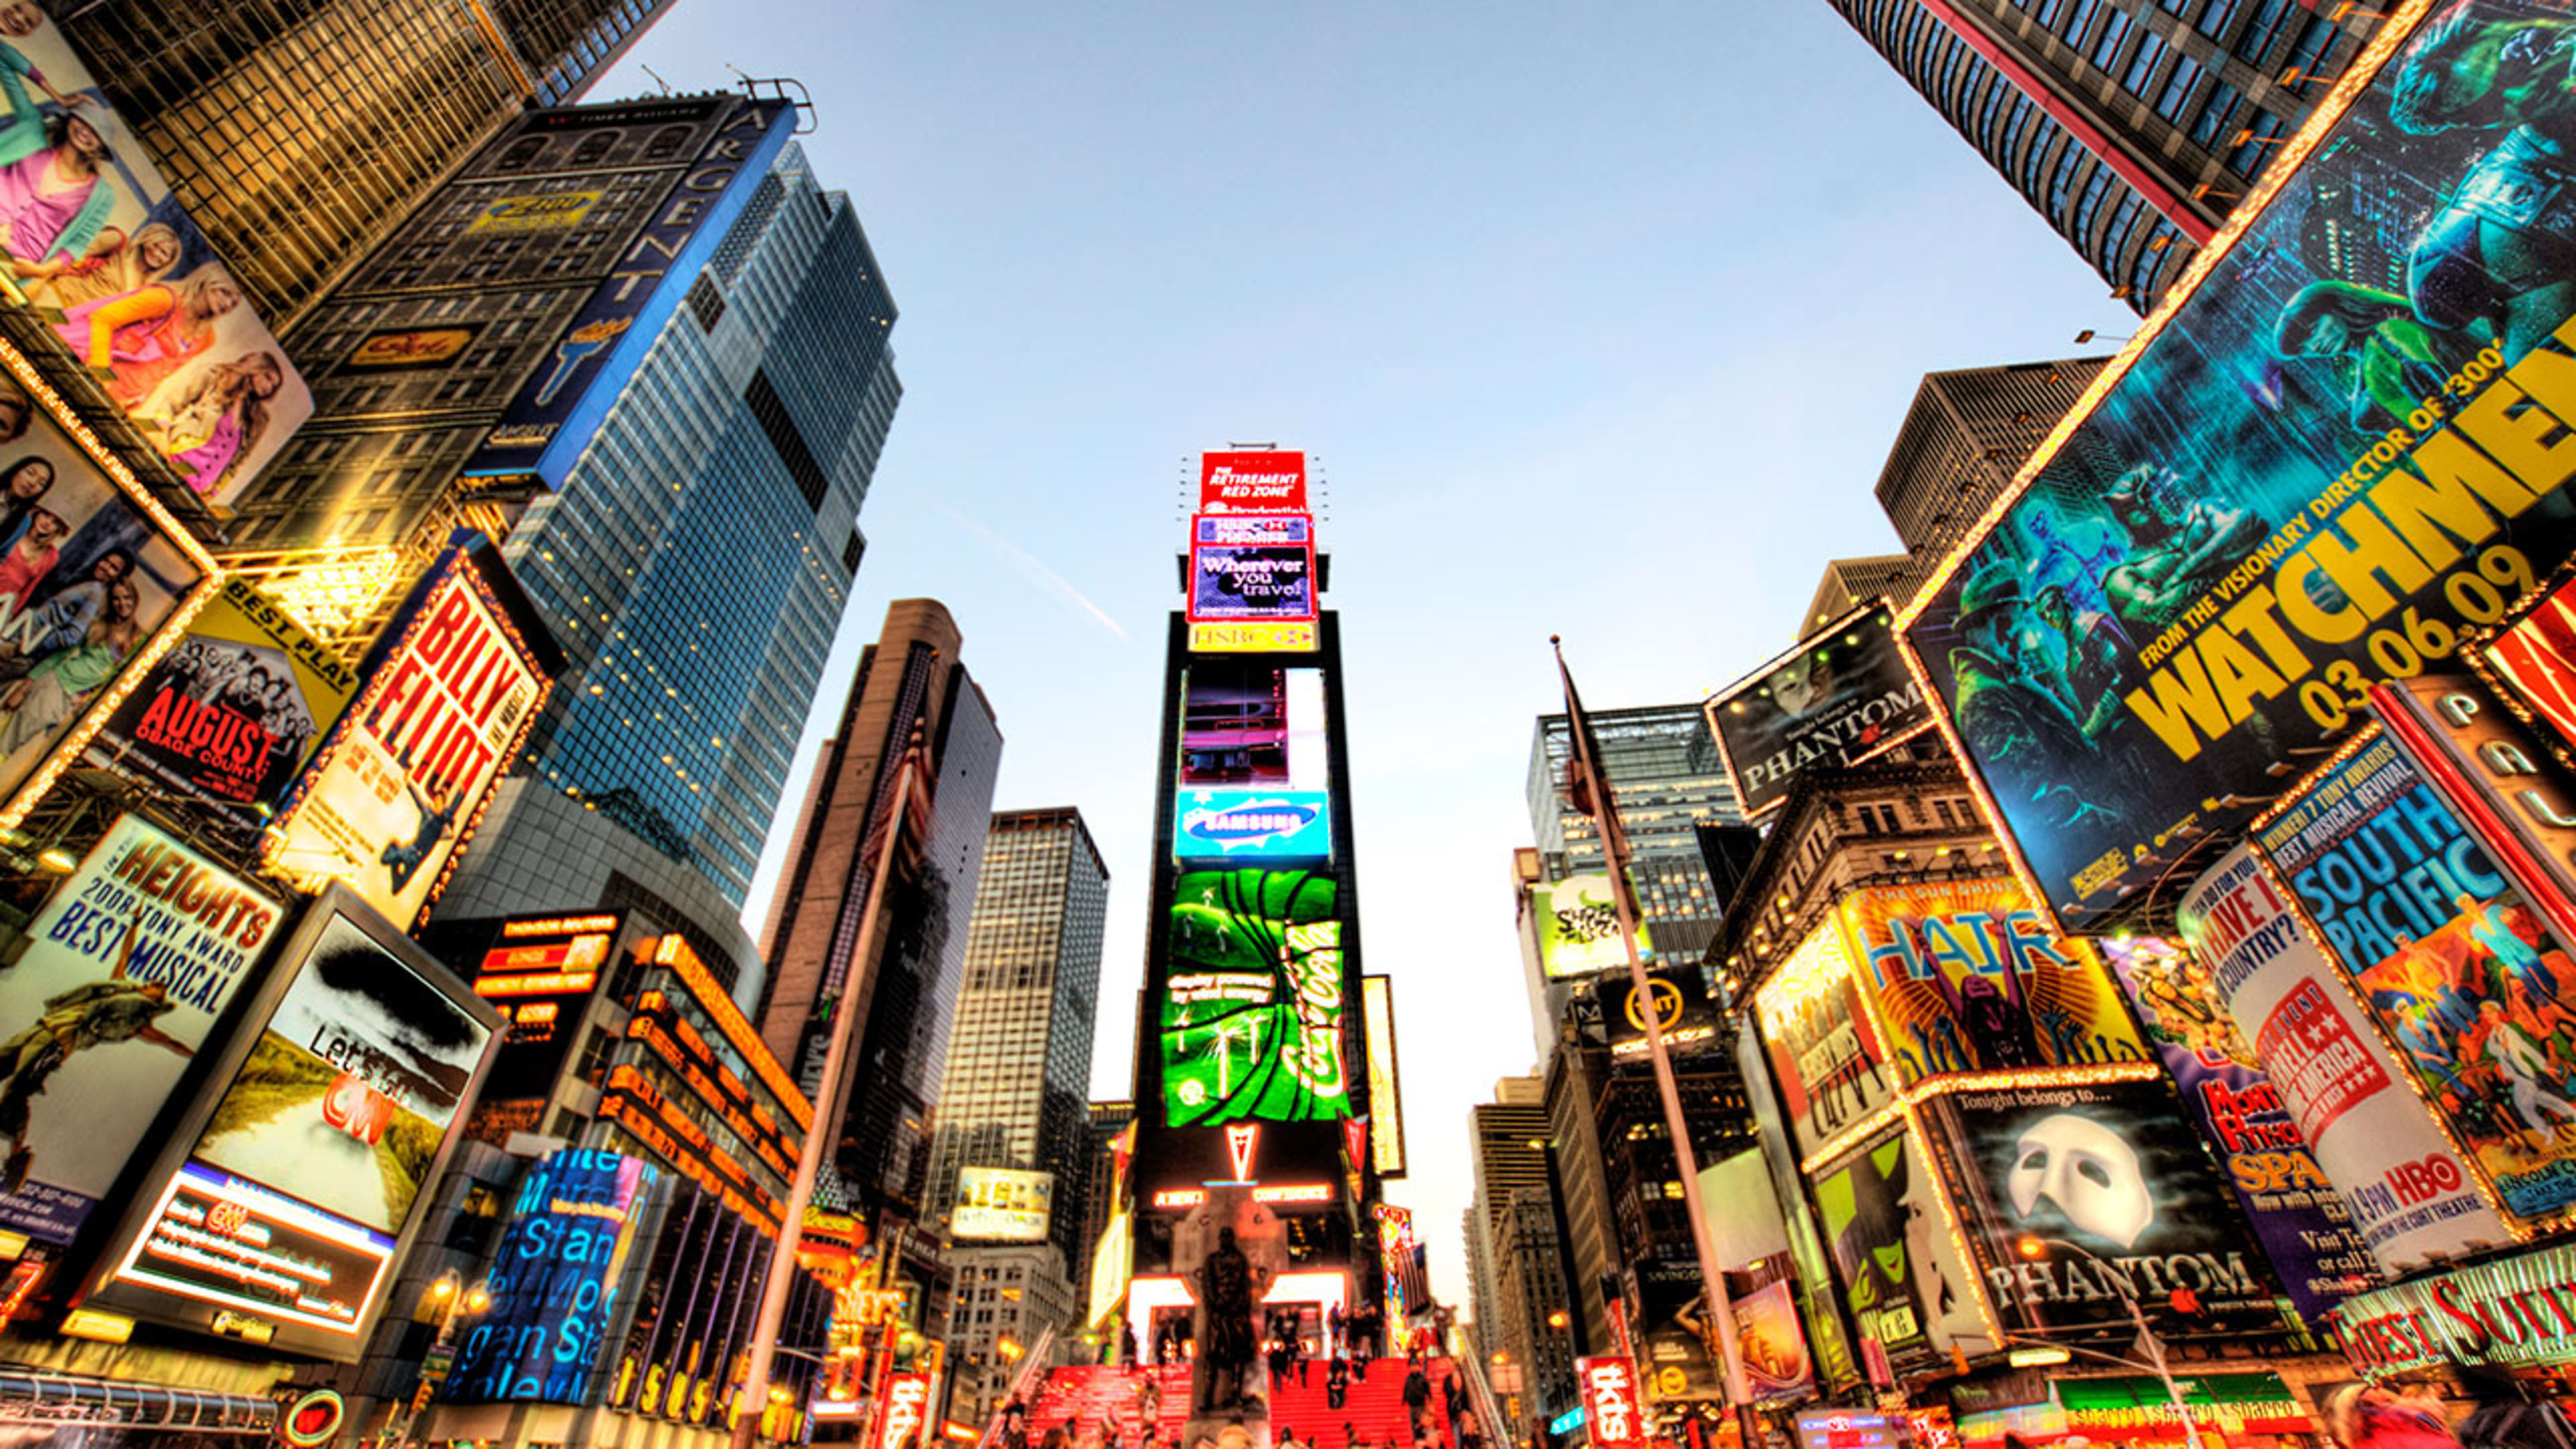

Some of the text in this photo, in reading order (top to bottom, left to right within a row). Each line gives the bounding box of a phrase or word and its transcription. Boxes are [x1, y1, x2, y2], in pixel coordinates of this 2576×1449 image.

[1209, 474, 1299, 485] RETIREMENT
[1221, 486, 1291, 498] RED ZONE
[1201, 556, 1303, 574] Wherever
[2139, 621, 2188, 670] FROM
[2183, 597, 2223, 640] THE
[2216, 514, 2314, 607] VISIONARY
[2309, 425, 2416, 521] DIRECTOR
[2407, 394, 2446, 433] OF
[1232, 572, 1273, 588] you
[1243, 582, 1304, 596] travel
[227, 580, 294, 635] BEST
[294, 637, 354, 687] PLAY
[415, 586, 521, 729] BILLY
[1194, 629, 1270, 645] HSBC
[136, 724, 268, 784] OSAGE COUNTY
[1743, 680, 1925, 793] PHANTOM
[2314, 776, 2350, 810] TONY
[2344, 740, 2397, 788] AWARDS
[1204, 814, 1302, 831] SAMSUNG
[2272, 758, 2415, 871] BEST MUSICAL REVIVAL
[2243, 845, 2271, 880] YOU
[2292, 783, 2463, 922] SOUTH
[111, 837, 273, 950] HEIGHTS
[1914, 883, 1952, 900] SUN
[1957, 878, 2015, 898] SHINE
[2202, 886, 2260, 962] HAVE
[2322, 835, 2509, 976] PACIFIC
[48, 900, 230, 1015] BEST MUSICAL
[81, 875, 136, 916] 2008
[185, 930, 246, 975] AWARD
[1857, 909, 2080, 990] HAIR
[2226, 912, 2300, 994] COUNTRY?
[1957, 1089, 2015, 1112] Tonight
[2017, 1087, 2078, 1110] belongs
[2296, 1033, 2367, 1107] AMERICA
[2230, 1150, 2332, 1191] SPA
[2384, 1152, 2463, 1208] HBO
[1988, 1249, 2260, 1309] PHANTOM
[1589, 1363, 1631, 1442] tkts
[2151, 1401, 2215, 1426] sbrro
[2230, 1397, 2296, 1419] sbarro
